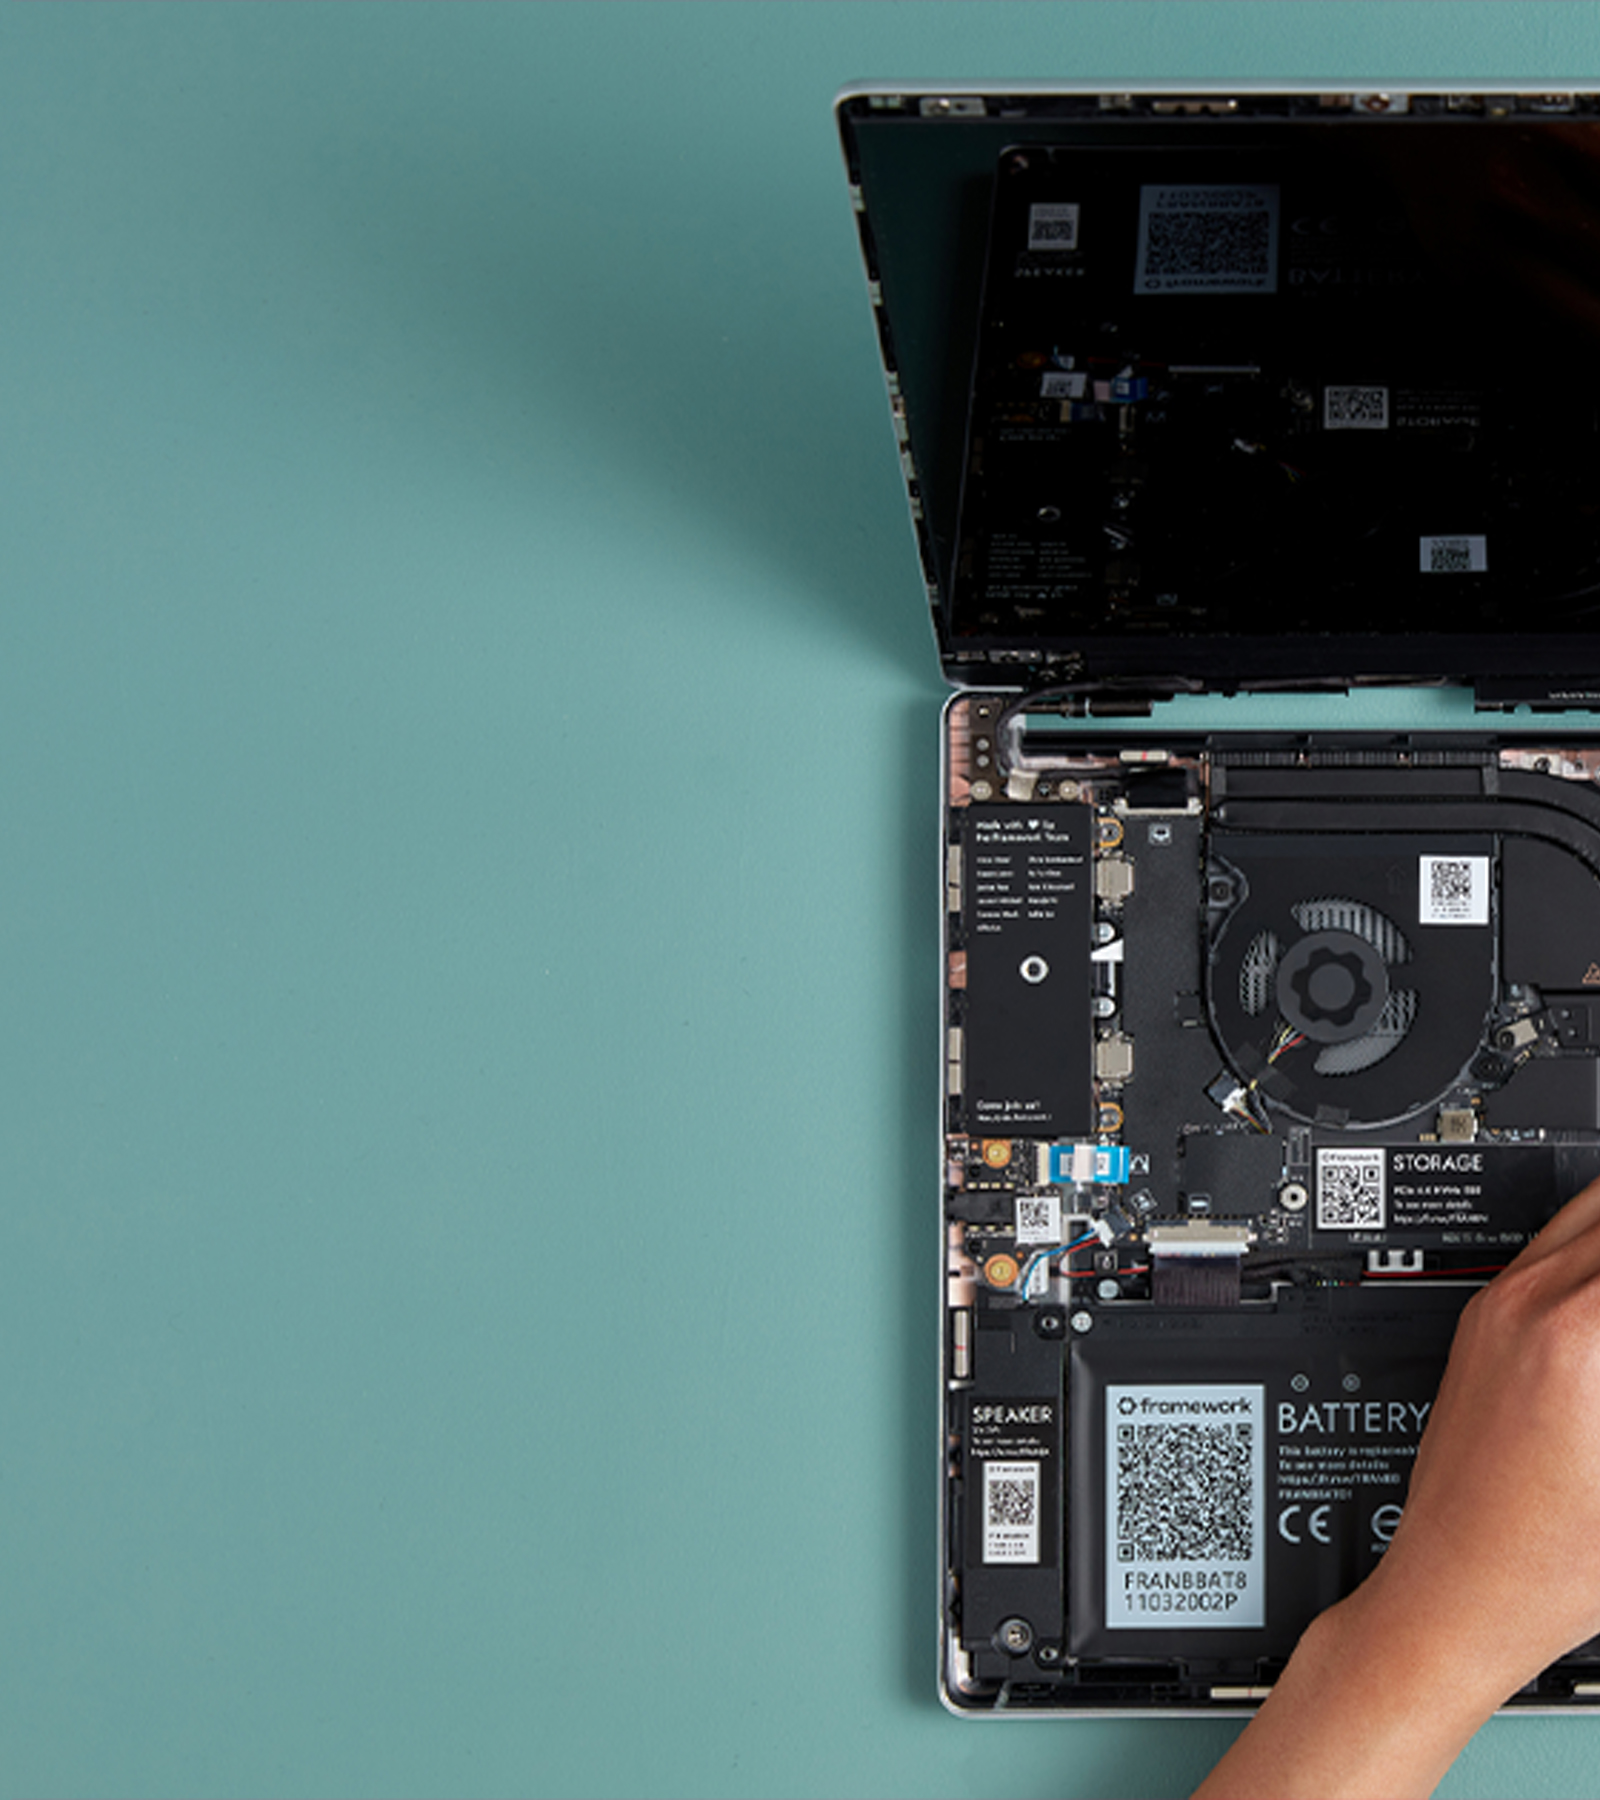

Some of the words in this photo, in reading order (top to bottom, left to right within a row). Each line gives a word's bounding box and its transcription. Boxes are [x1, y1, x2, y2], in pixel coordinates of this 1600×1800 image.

[1393, 1154, 1484, 1172] STORAGE
[972, 1405, 1052, 1423] SPEAKER
[1140, 1397, 1252, 1415] framework
[1278, 1402, 1430, 1433] BATTERY
[1304, 1445, 1346, 1457] battery
[1125, 1571, 1247, 1589] FRANBBAT8
[1125, 1594, 1239, 1612] 11032002P
